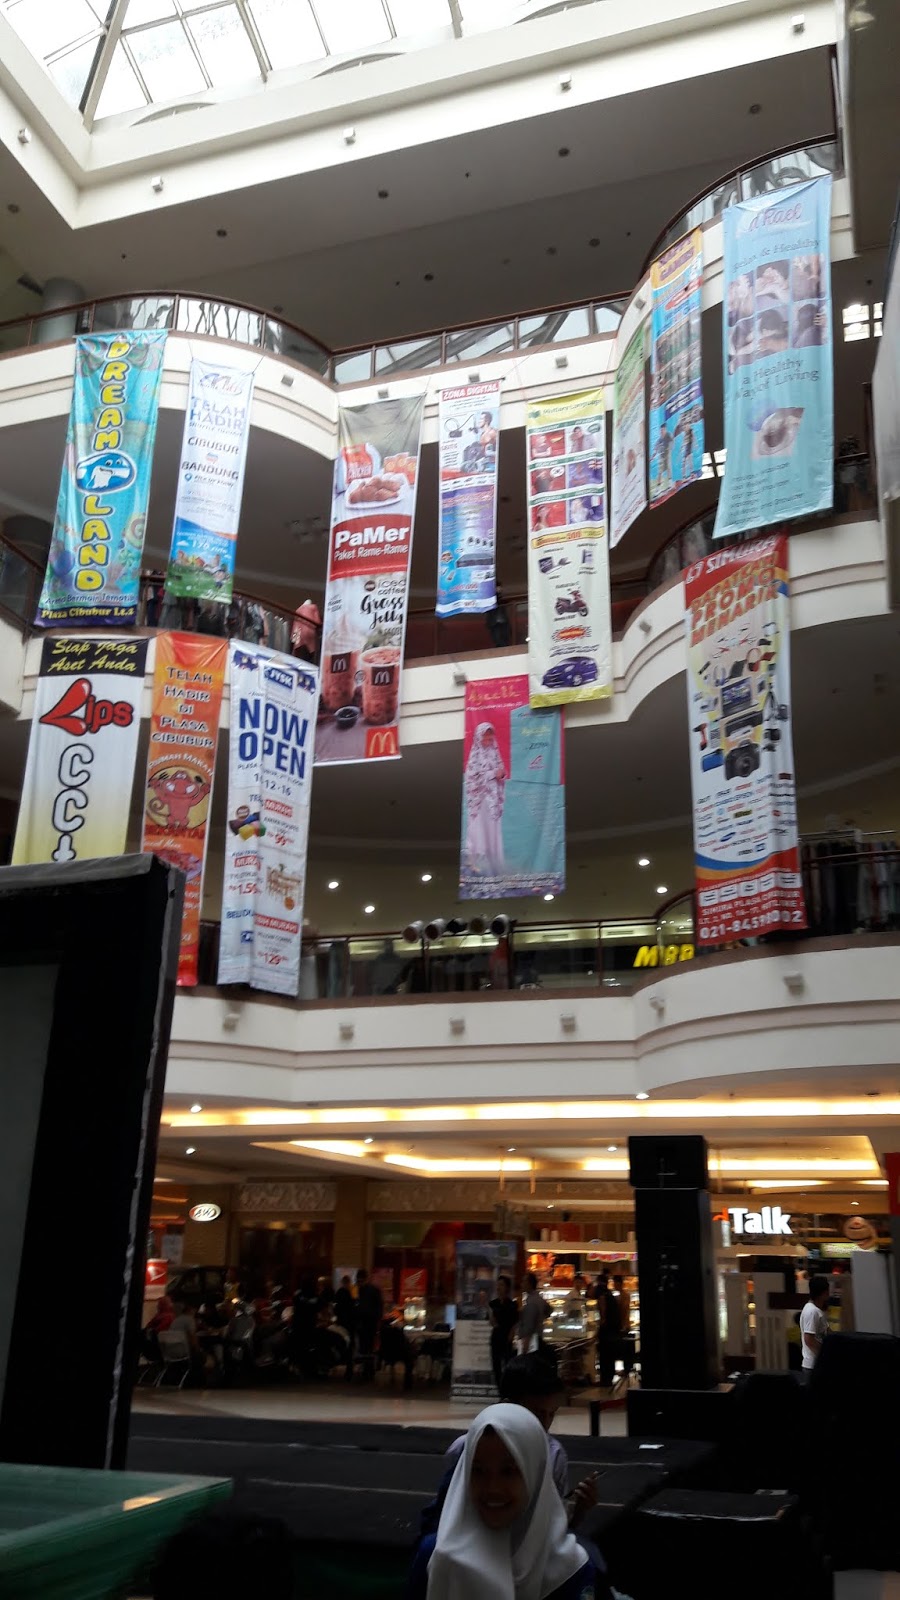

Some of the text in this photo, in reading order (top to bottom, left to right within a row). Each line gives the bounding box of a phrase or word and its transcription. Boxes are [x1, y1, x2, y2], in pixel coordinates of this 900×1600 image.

[92, 340, 131, 452] DREAM
[443, 383, 498, 400] ZONA DIGITAL
[191, 395, 246, 419] TELAH
[190, 409, 244, 431] HADIR
[187, 436, 240, 455] CIBUBUR
[181, 461, 240, 480] BANDUNG
[75, 495, 112, 592] LAND
[335, 525, 410, 549] PaMer
[334, 543, 409, 560] Paket Rame-Rame
[378, 578, 406, 589] iced
[691, 567, 775, 630] PROMO
[41, 609, 67, 619] Plaza
[69, 607, 111, 617] Cibubur
[52, 638, 91, 656] Siap
[47, 654, 137, 673] Aset Anda
[166, 666, 213, 684] TELAH
[163, 685, 211, 702] HADIR
[178, 703, 195, 715] DI
[160, 715, 209, 733] PLASA
[239, 698, 309, 748] NOW
[151, 732, 215, 749] CIBUBUR
[239, 731, 306, 779] OPEN
